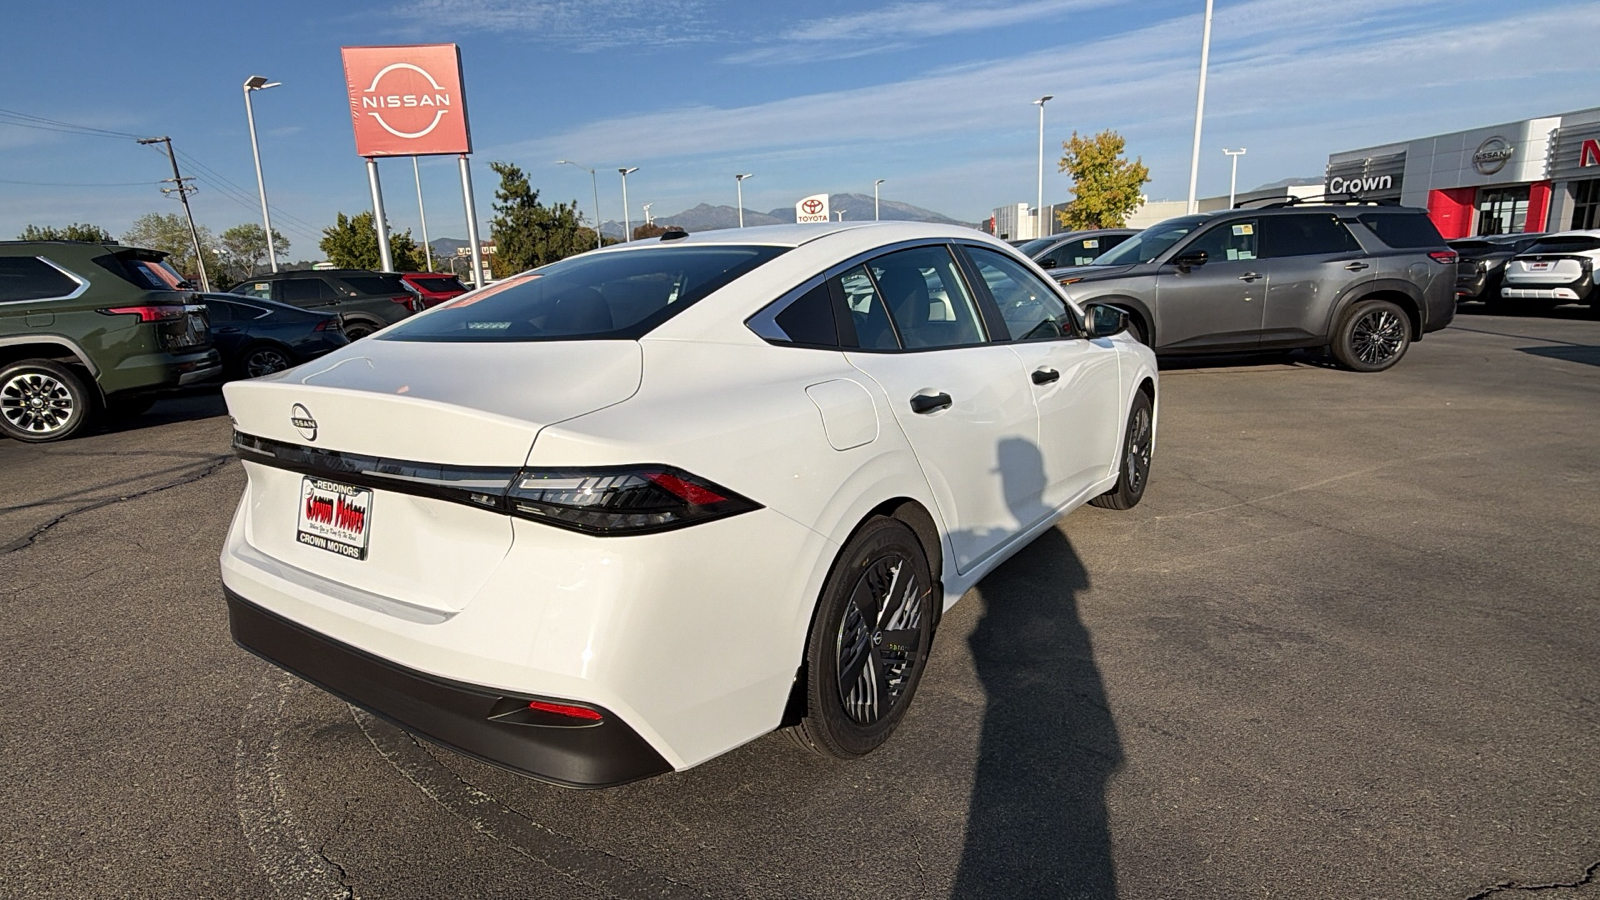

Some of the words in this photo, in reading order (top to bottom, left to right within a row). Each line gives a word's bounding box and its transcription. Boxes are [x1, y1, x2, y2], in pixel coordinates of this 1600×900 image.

[362, 94, 450, 108] NISSAN
[1475, 151, 1507, 160] NISSAN
[1330, 175, 1391, 193] Crown
[317, 480, 353, 495] REDDING
[300, 533, 326, 548] CROWN
[327, 540, 359, 557] MOTORS
